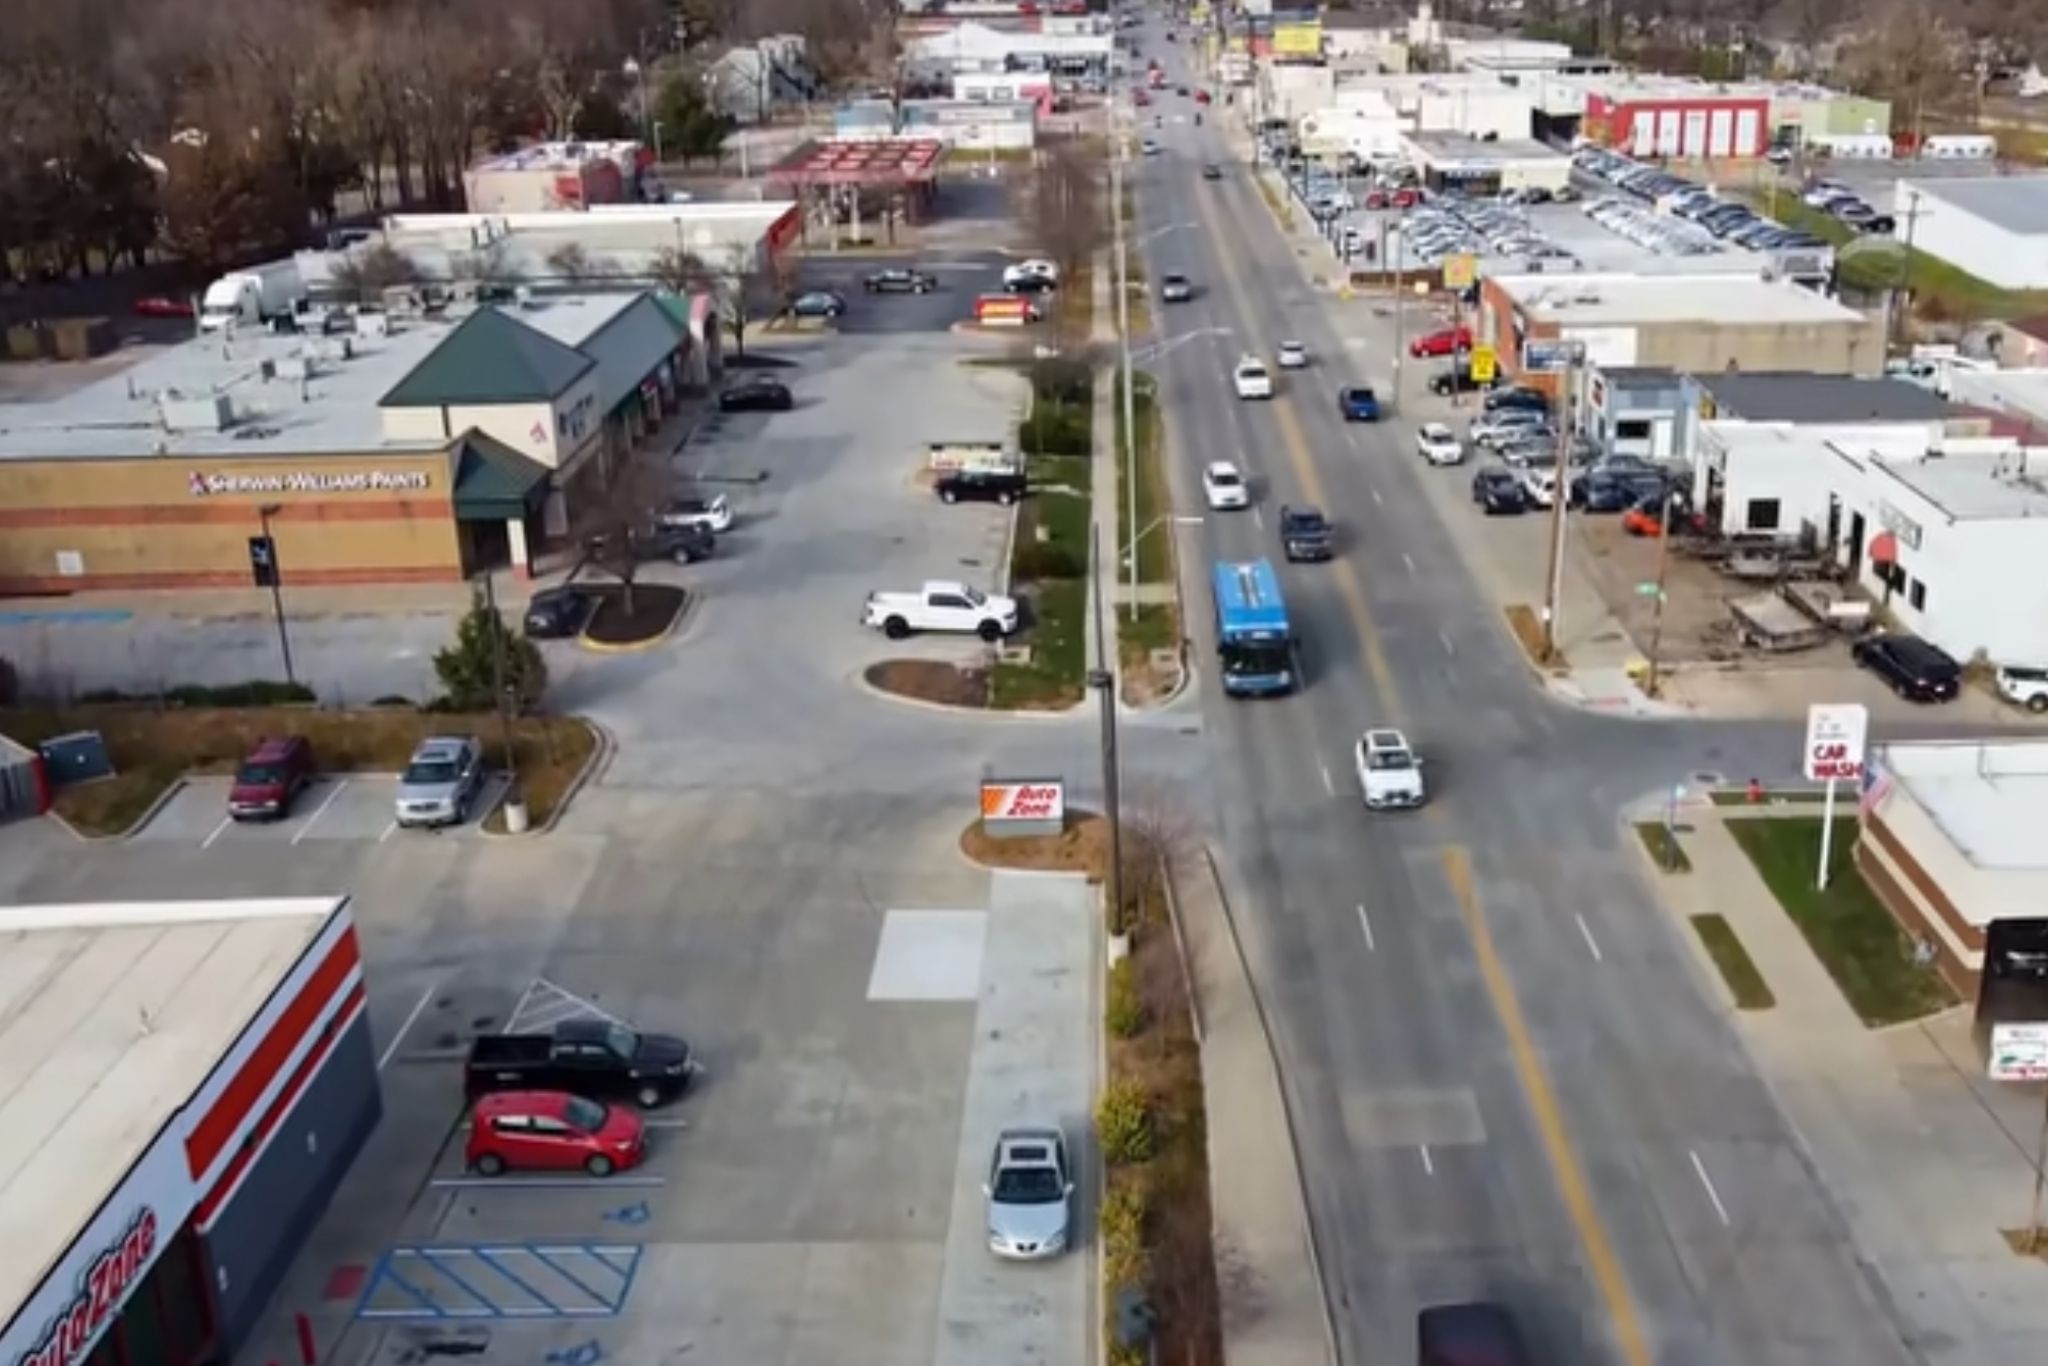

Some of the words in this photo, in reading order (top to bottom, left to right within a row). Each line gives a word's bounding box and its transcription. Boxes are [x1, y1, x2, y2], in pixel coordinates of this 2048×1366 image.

[373, 471, 428, 489] PAINTS
[1814, 744, 1847, 760] CAR
[1017, 785, 1057, 799] Auto
[1007, 801, 1051, 816] Zone
